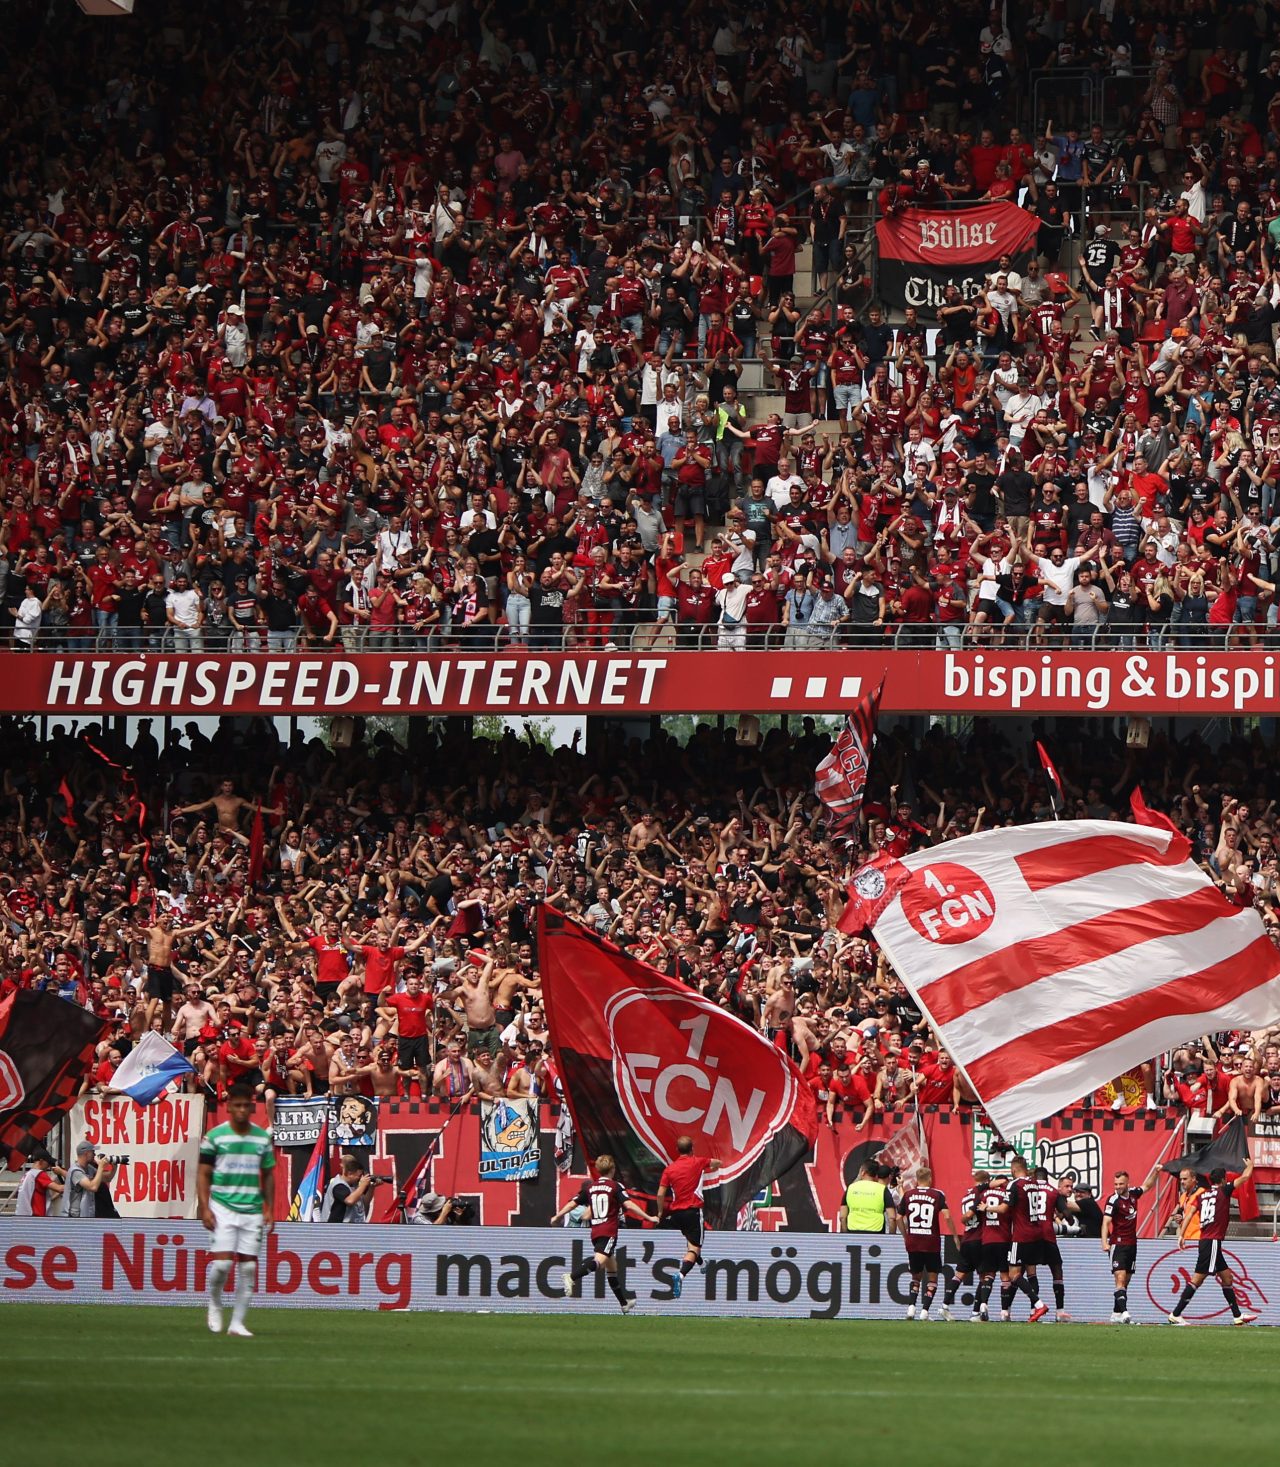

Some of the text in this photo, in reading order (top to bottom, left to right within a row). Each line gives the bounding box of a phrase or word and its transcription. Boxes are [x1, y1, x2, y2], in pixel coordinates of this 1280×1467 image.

[918, 217, 998, 252] Böhse
[47, 658, 667, 706] HIGHSPEED-INTERNET
[945, 654, 1109, 708] bisping
[1120, 655, 1156, 697] &
[924, 869, 956, 898] 1.
[918, 889, 994, 941] FCN
[679, 1013, 718, 1068] 1.
[84, 1098, 190, 1146] SEKTION
[274, 1109, 337, 1125] ULTRAS
[625, 1052, 766, 1154] FCN
[273, 1127, 337, 1141] GÖTEBOG
[104, 1159, 186, 1203] ADION
[479, 1149, 541, 1174] ULTRAS
[591, 1193, 609, 1219] 10
[908, 1202, 934, 1228] 29
[436, 1239, 681, 1299] macht's
